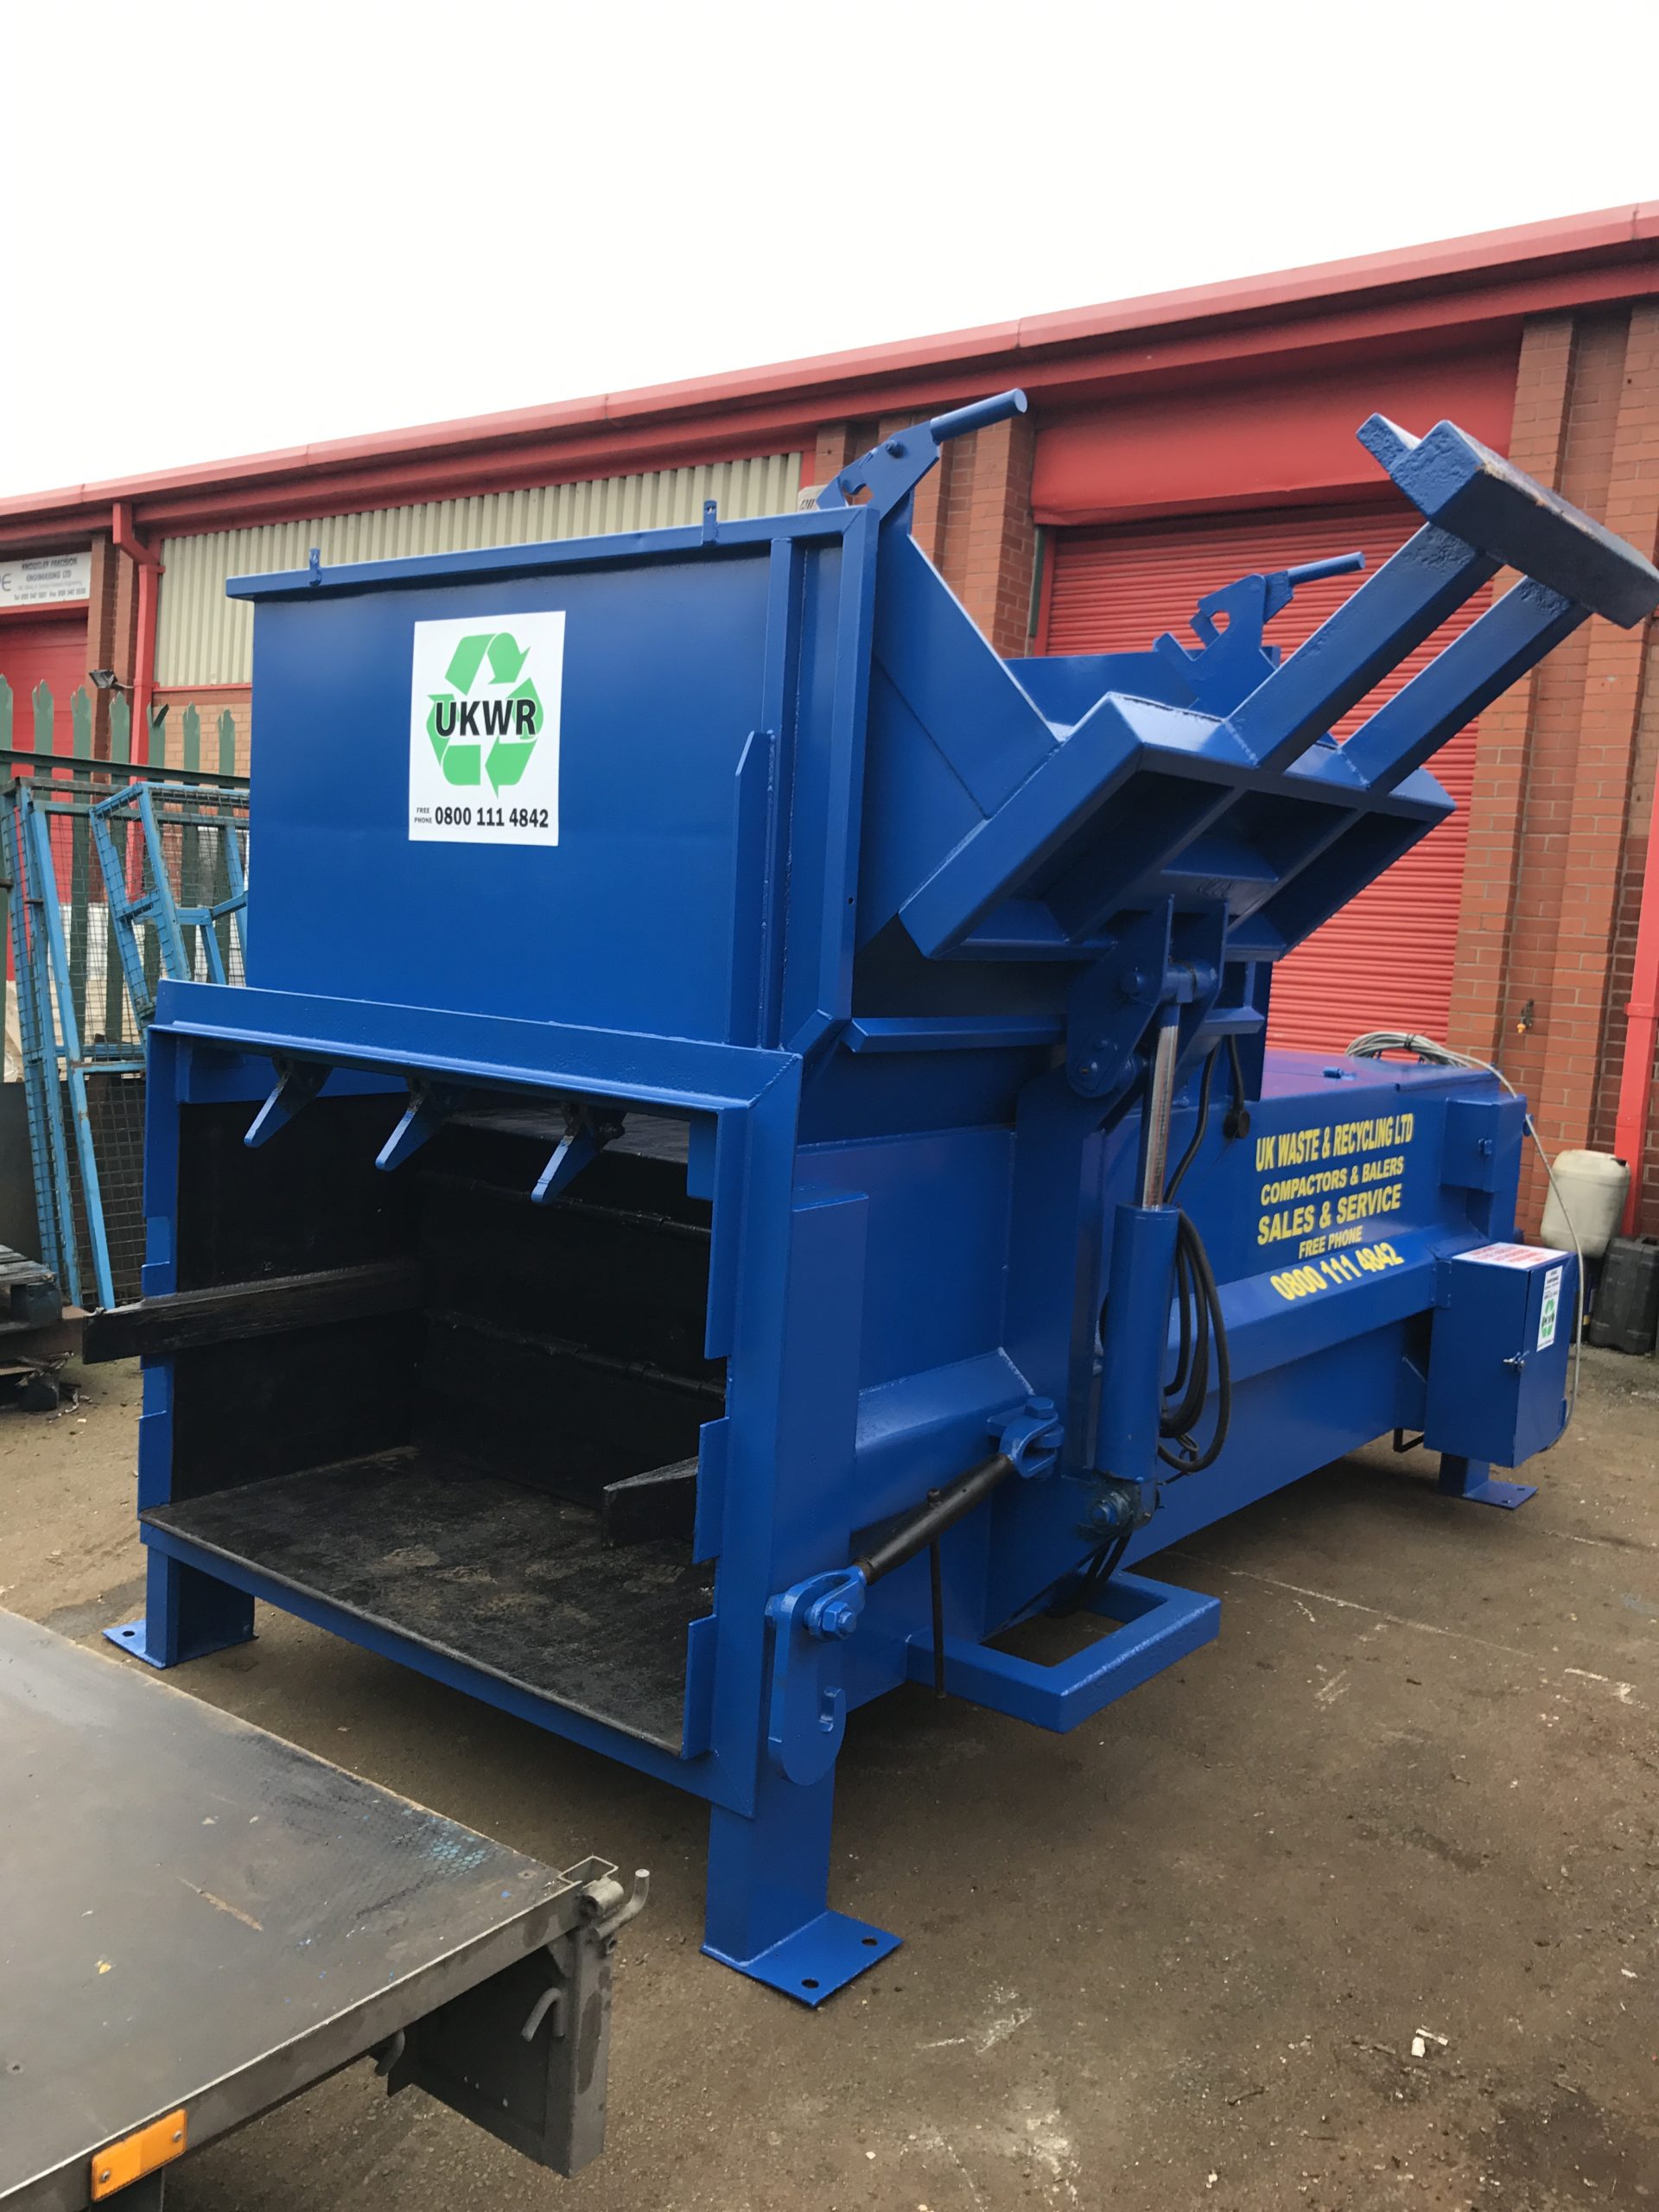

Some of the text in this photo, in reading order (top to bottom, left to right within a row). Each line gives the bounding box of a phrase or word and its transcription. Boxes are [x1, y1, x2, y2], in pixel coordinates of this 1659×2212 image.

[435, 698, 537, 737] UKWR
[435, 806, 549, 828] 0800 111 4842
[1255, 1113, 1414, 1173] UK WASTE & RECYCLING LTD
[1261, 1155, 1405, 1206] COMPACTORS & BALERS
[1257, 1183, 1403, 1245] SALES & SERVICE
[1299, 1224, 1363, 1259] FREE PHONE
[1269, 1242, 1405, 1300] 0800 111 4842
